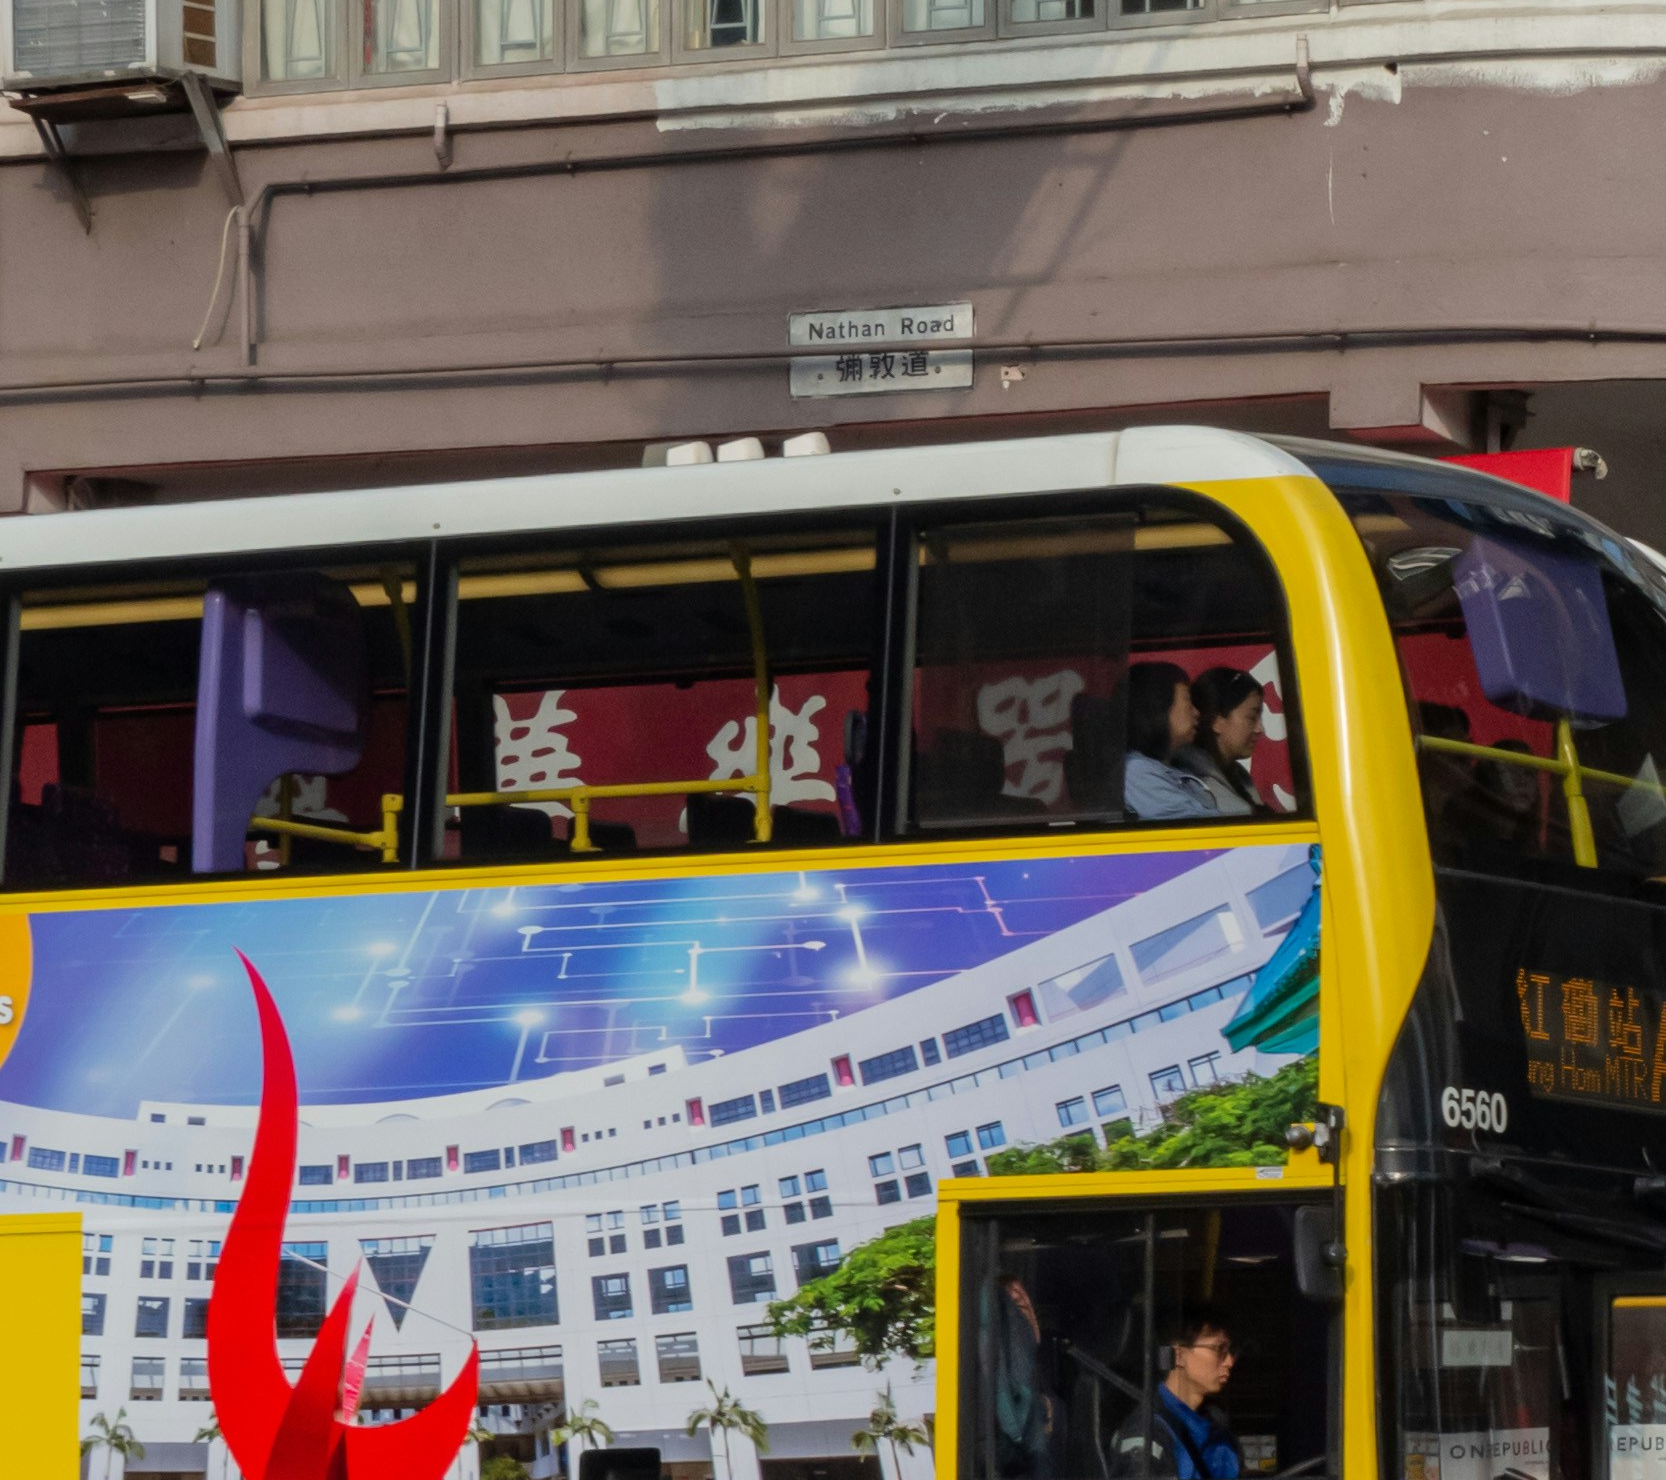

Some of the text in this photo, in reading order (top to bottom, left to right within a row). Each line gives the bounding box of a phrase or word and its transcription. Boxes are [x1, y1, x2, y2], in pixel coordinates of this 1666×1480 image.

[809, 315, 955, 340] Nathan Road
[835, 351, 930, 383] 彌敦道
[1605, 1054, 1649, 1101] MTR
[1441, 1086, 1507, 1134] 6560
